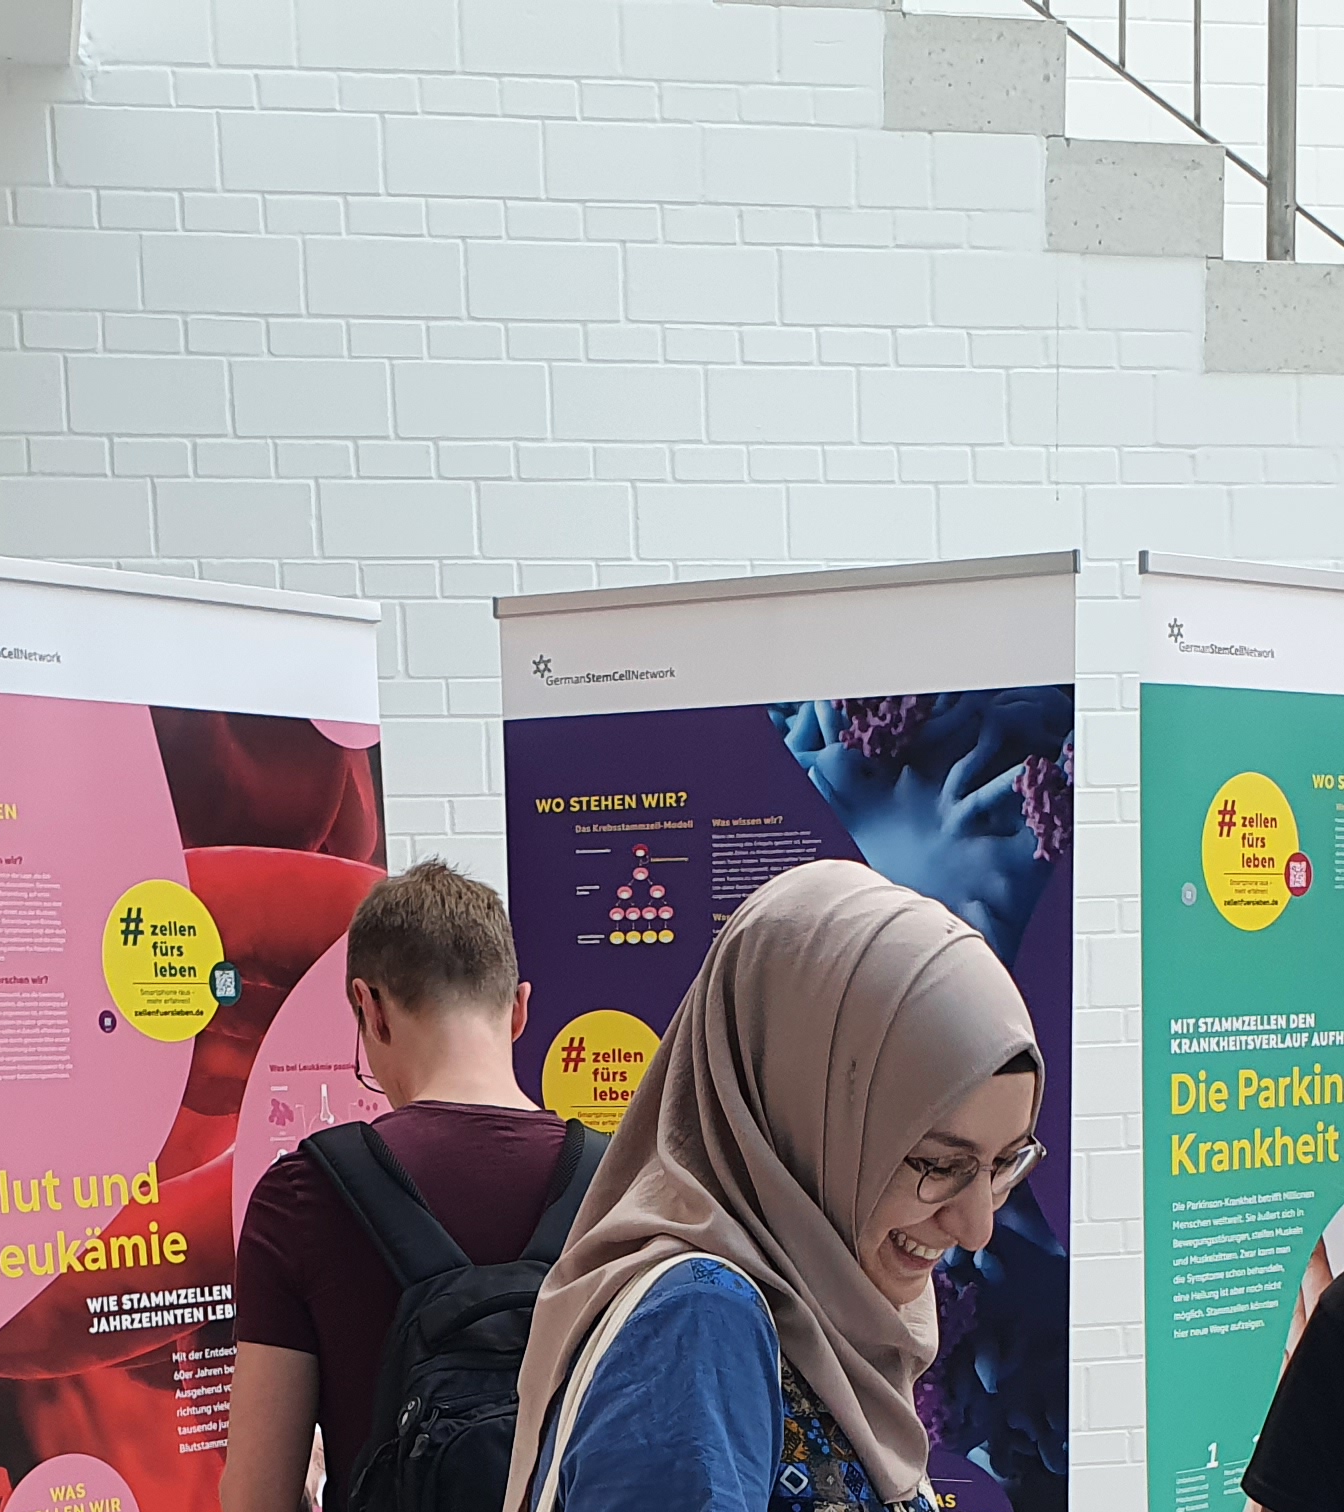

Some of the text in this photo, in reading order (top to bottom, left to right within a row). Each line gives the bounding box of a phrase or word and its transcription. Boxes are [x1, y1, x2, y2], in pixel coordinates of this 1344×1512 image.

[546, 667, 676, 686] GermanStemCellNetwork
[1312, 774, 1335, 790] WO
[535, 791, 688, 813] WO STEHEN WIR?
[1217, 800, 1278, 838] # zellen
[1241, 832, 1266, 849] fürs
[1241, 853, 1275, 869] leben
[120, 907, 197, 946] # zellen
[152, 941, 184, 957] fürs
[154, 962, 197, 978] leben
[1170, 1013, 1316, 1035] MIT STAMMZELLEN DEN
[1170, 1032, 1309, 1055] KRANKHEITSVERLAUF
[561, 1037, 644, 1073] # zellen
[592, 1067, 628, 1082] fürs
[1170, 1070, 1228, 1116] Die
[1170, 1122, 1340, 1176] Krankheit
[73, 1162, 160, 1209] und
[86, 1284, 233, 1314] WIE STAMMZELLEN
[88, 1306, 204, 1334] JAHRZEHNTEN
[172, 1350, 203, 1363] Mit der
[173, 1367, 223, 1381] 60er Jahren
[175, 1383, 223, 1400] Ausgehend
[177, 1403, 212, 1418] richtung
[178, 1420, 218, 1436] tausende
[50, 1483, 86, 1502] WAS
